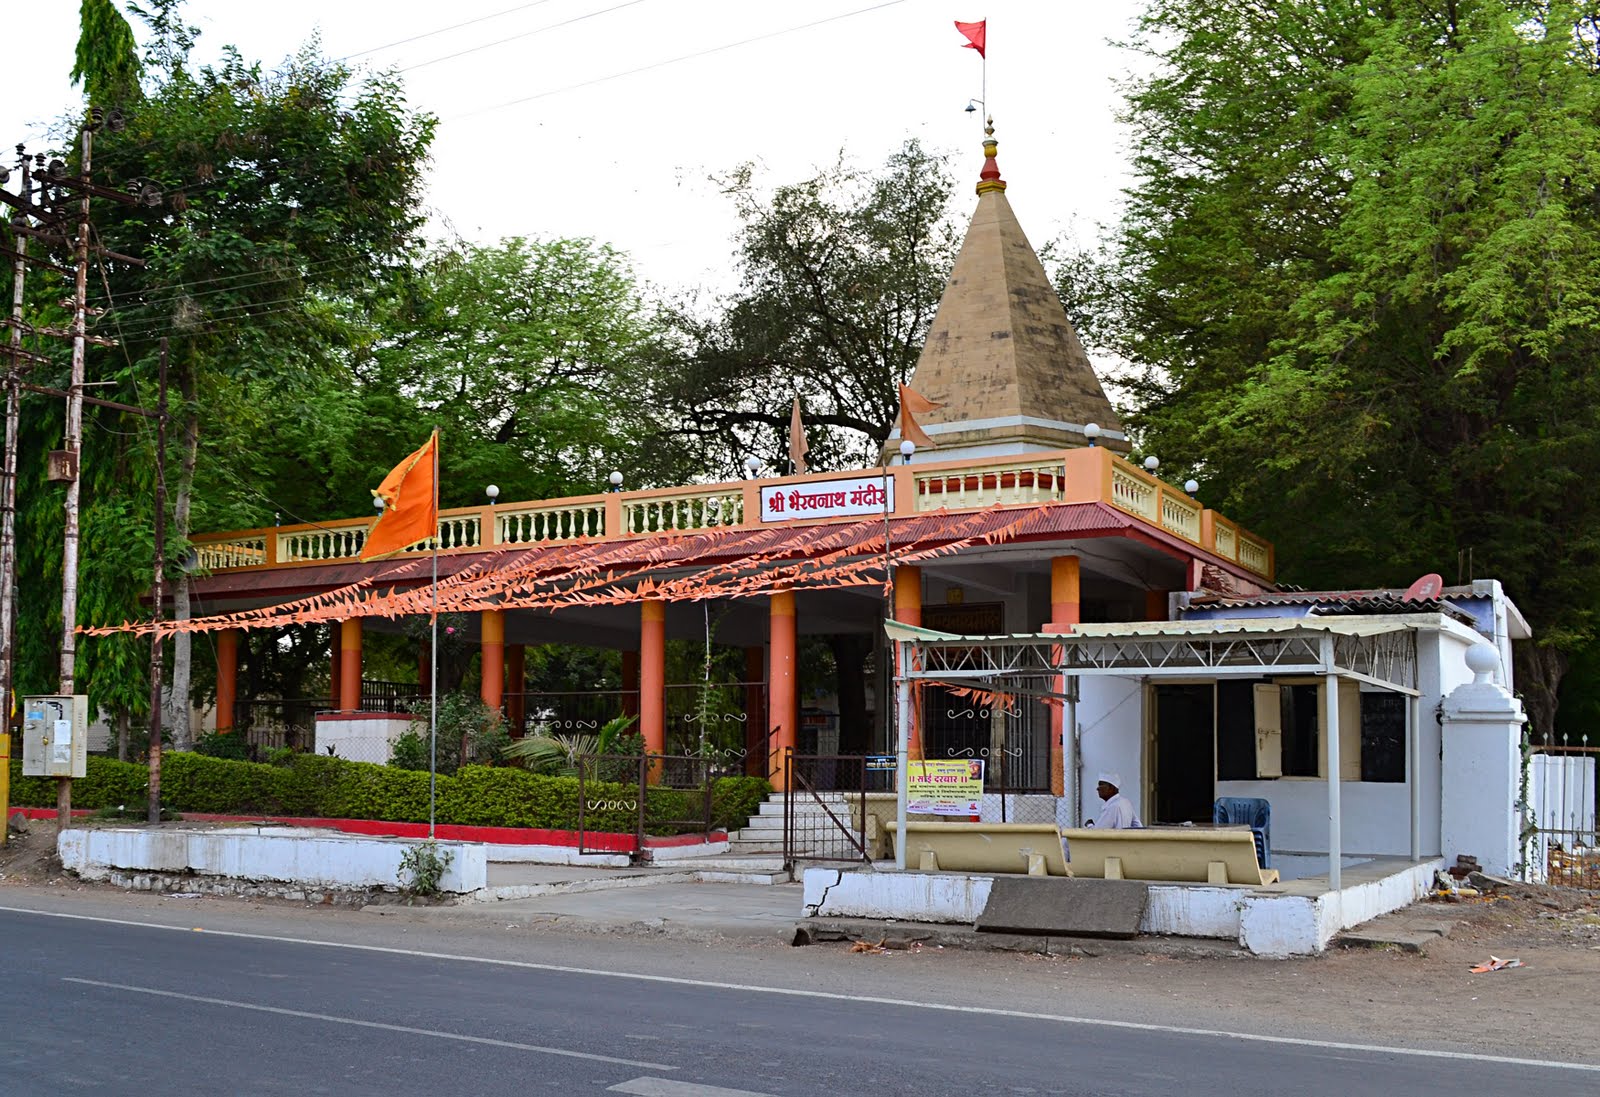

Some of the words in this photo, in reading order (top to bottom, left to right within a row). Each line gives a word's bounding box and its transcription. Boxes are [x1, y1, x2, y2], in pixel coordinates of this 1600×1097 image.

[769, 491, 785, 512] श्री
[788, 489, 846, 511] भैरवनाथ
[934, 775, 958, 783] दरबार
